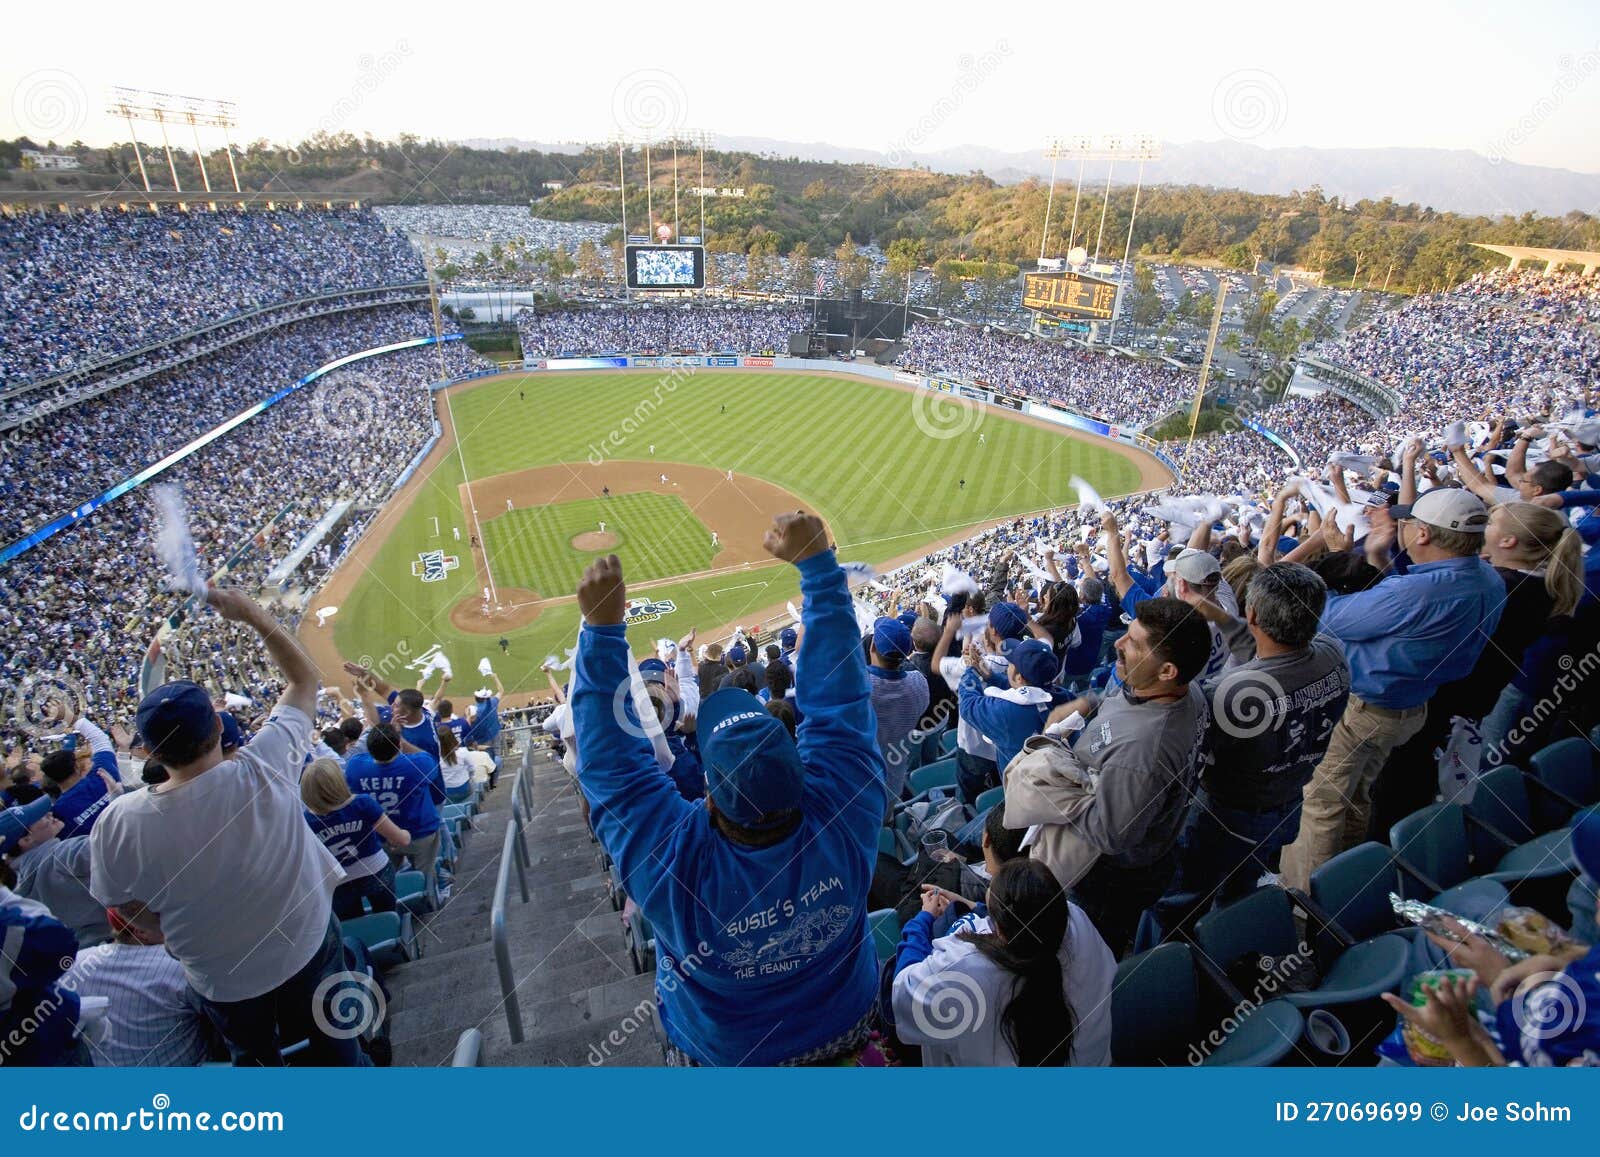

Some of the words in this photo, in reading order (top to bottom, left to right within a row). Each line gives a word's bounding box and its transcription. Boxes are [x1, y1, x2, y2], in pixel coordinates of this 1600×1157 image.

[722, 187, 745, 197] BLUE
[360, 776, 405, 791] KENT
[318, 820, 363, 843] CIAPARRA
[727, 899, 795, 937] SUSIE'S
[800, 877, 844, 907] TEAM
[734, 966, 757, 980] THE
[760, 959, 801, 975] PEANUT
